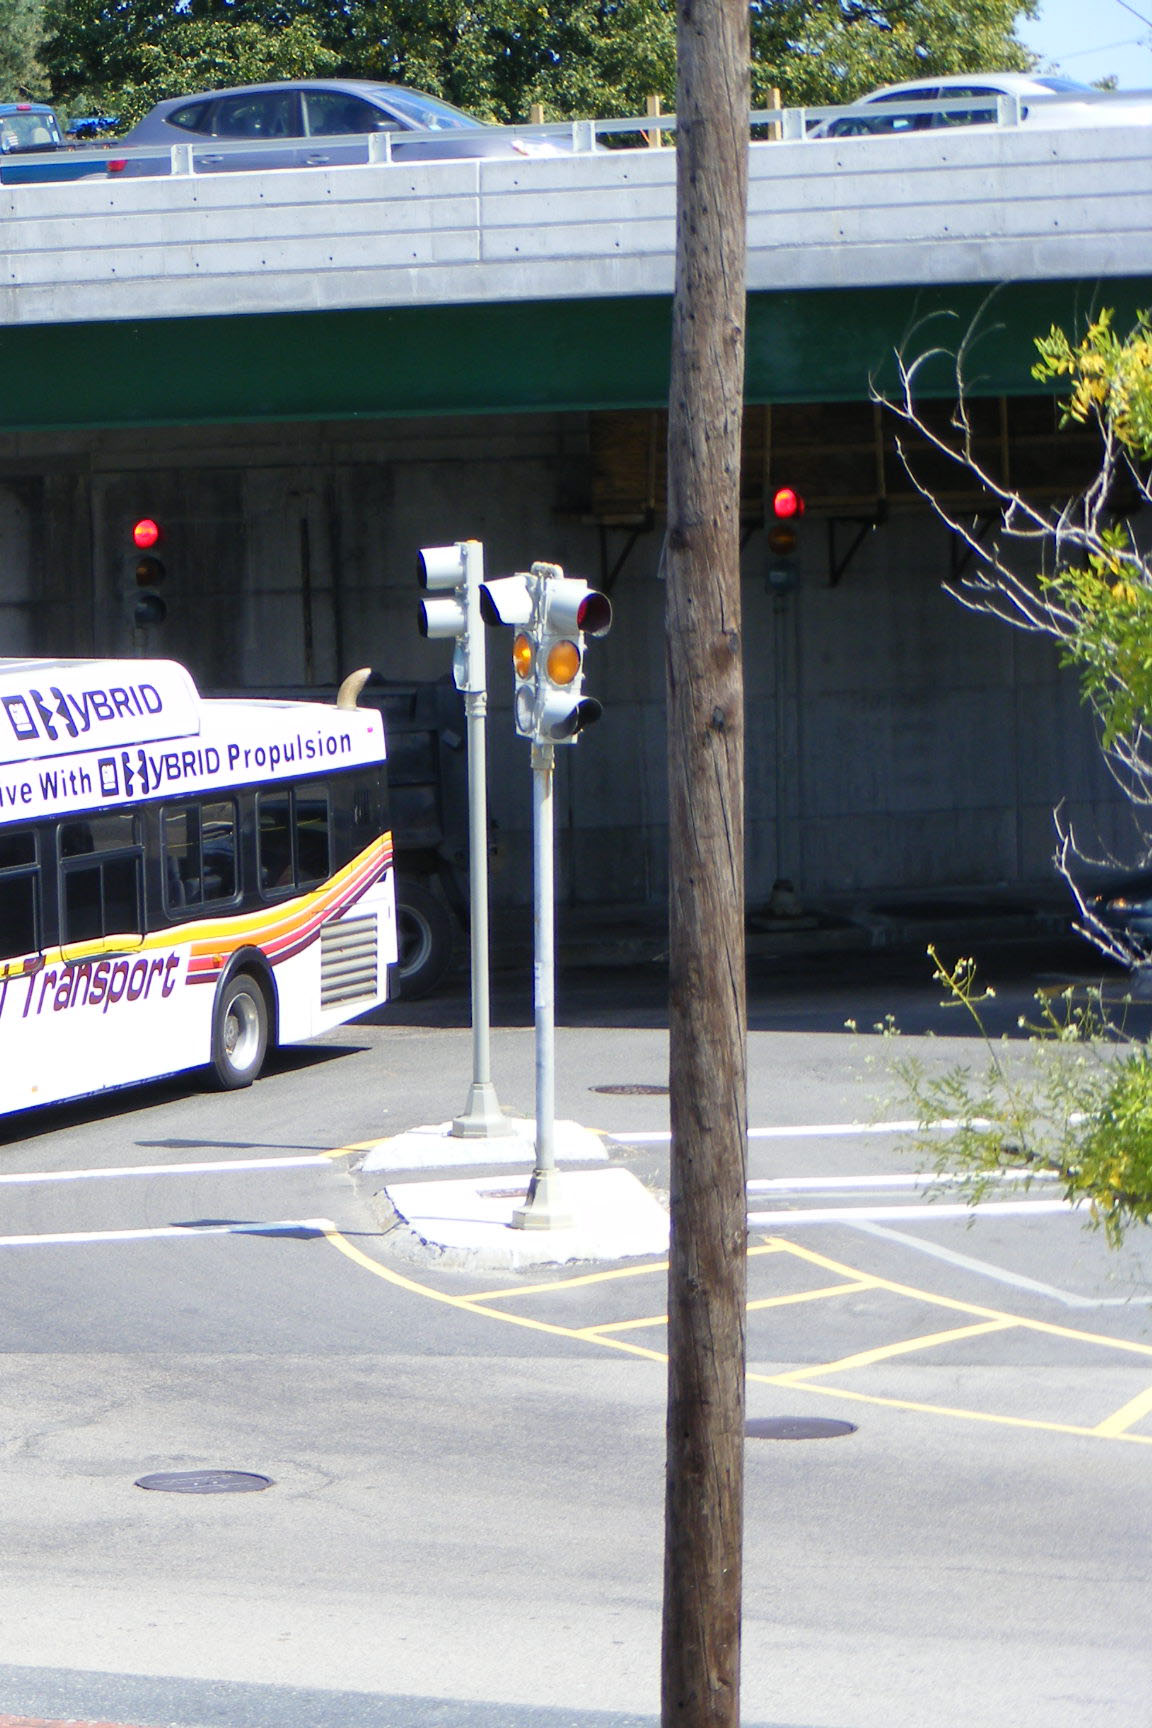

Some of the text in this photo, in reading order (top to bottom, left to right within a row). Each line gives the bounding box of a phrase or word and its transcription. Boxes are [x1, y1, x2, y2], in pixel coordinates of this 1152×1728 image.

[39, 766, 92, 801] With
[228, 732, 352, 772] Propulsion
[22, 951, 180, 1018] Transport
